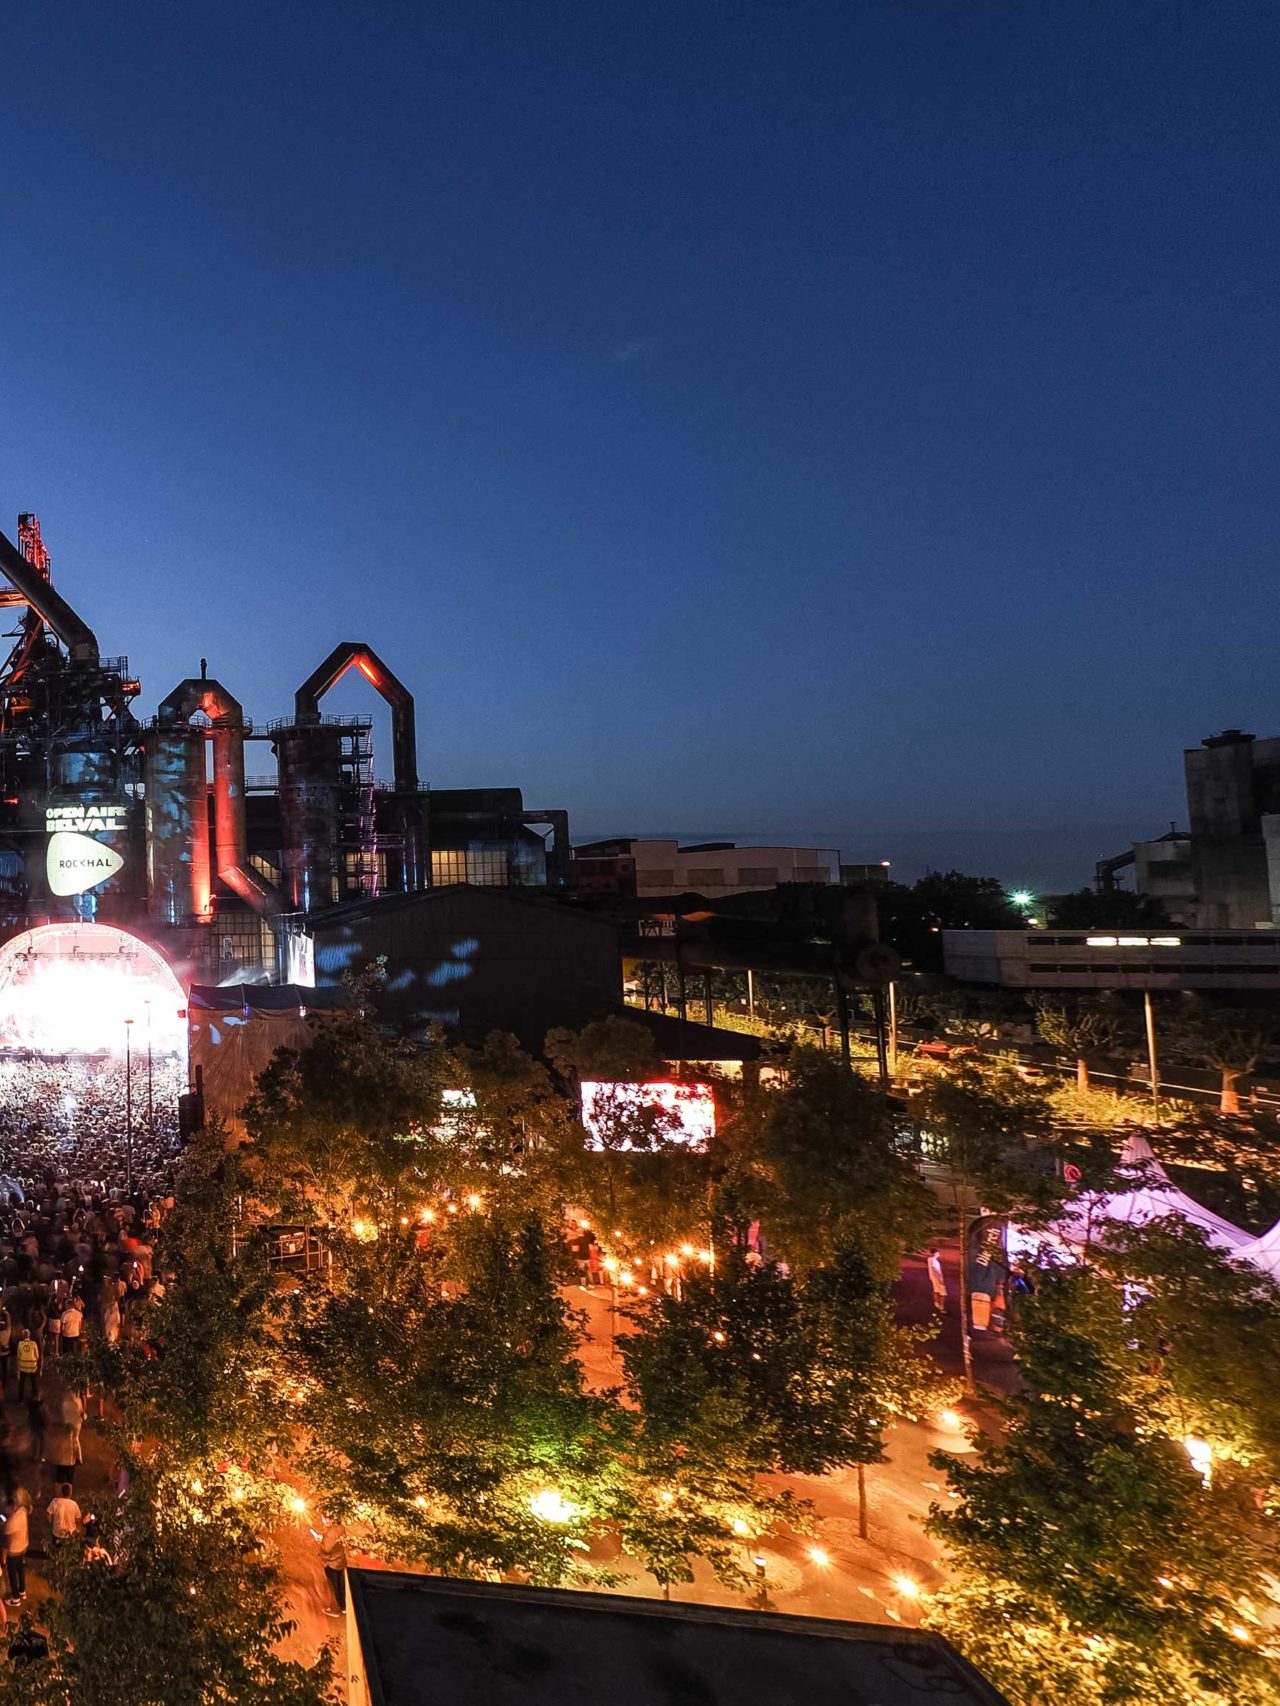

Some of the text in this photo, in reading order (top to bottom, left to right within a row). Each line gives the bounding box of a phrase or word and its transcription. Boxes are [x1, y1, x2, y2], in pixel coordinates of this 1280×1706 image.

[46, 806, 127, 819] OPEN AIR
[46, 817, 128, 832] BELVAL
[59, 858, 113, 869] ROCKHAL
[975, 1227, 1001, 1267] Dieirch
